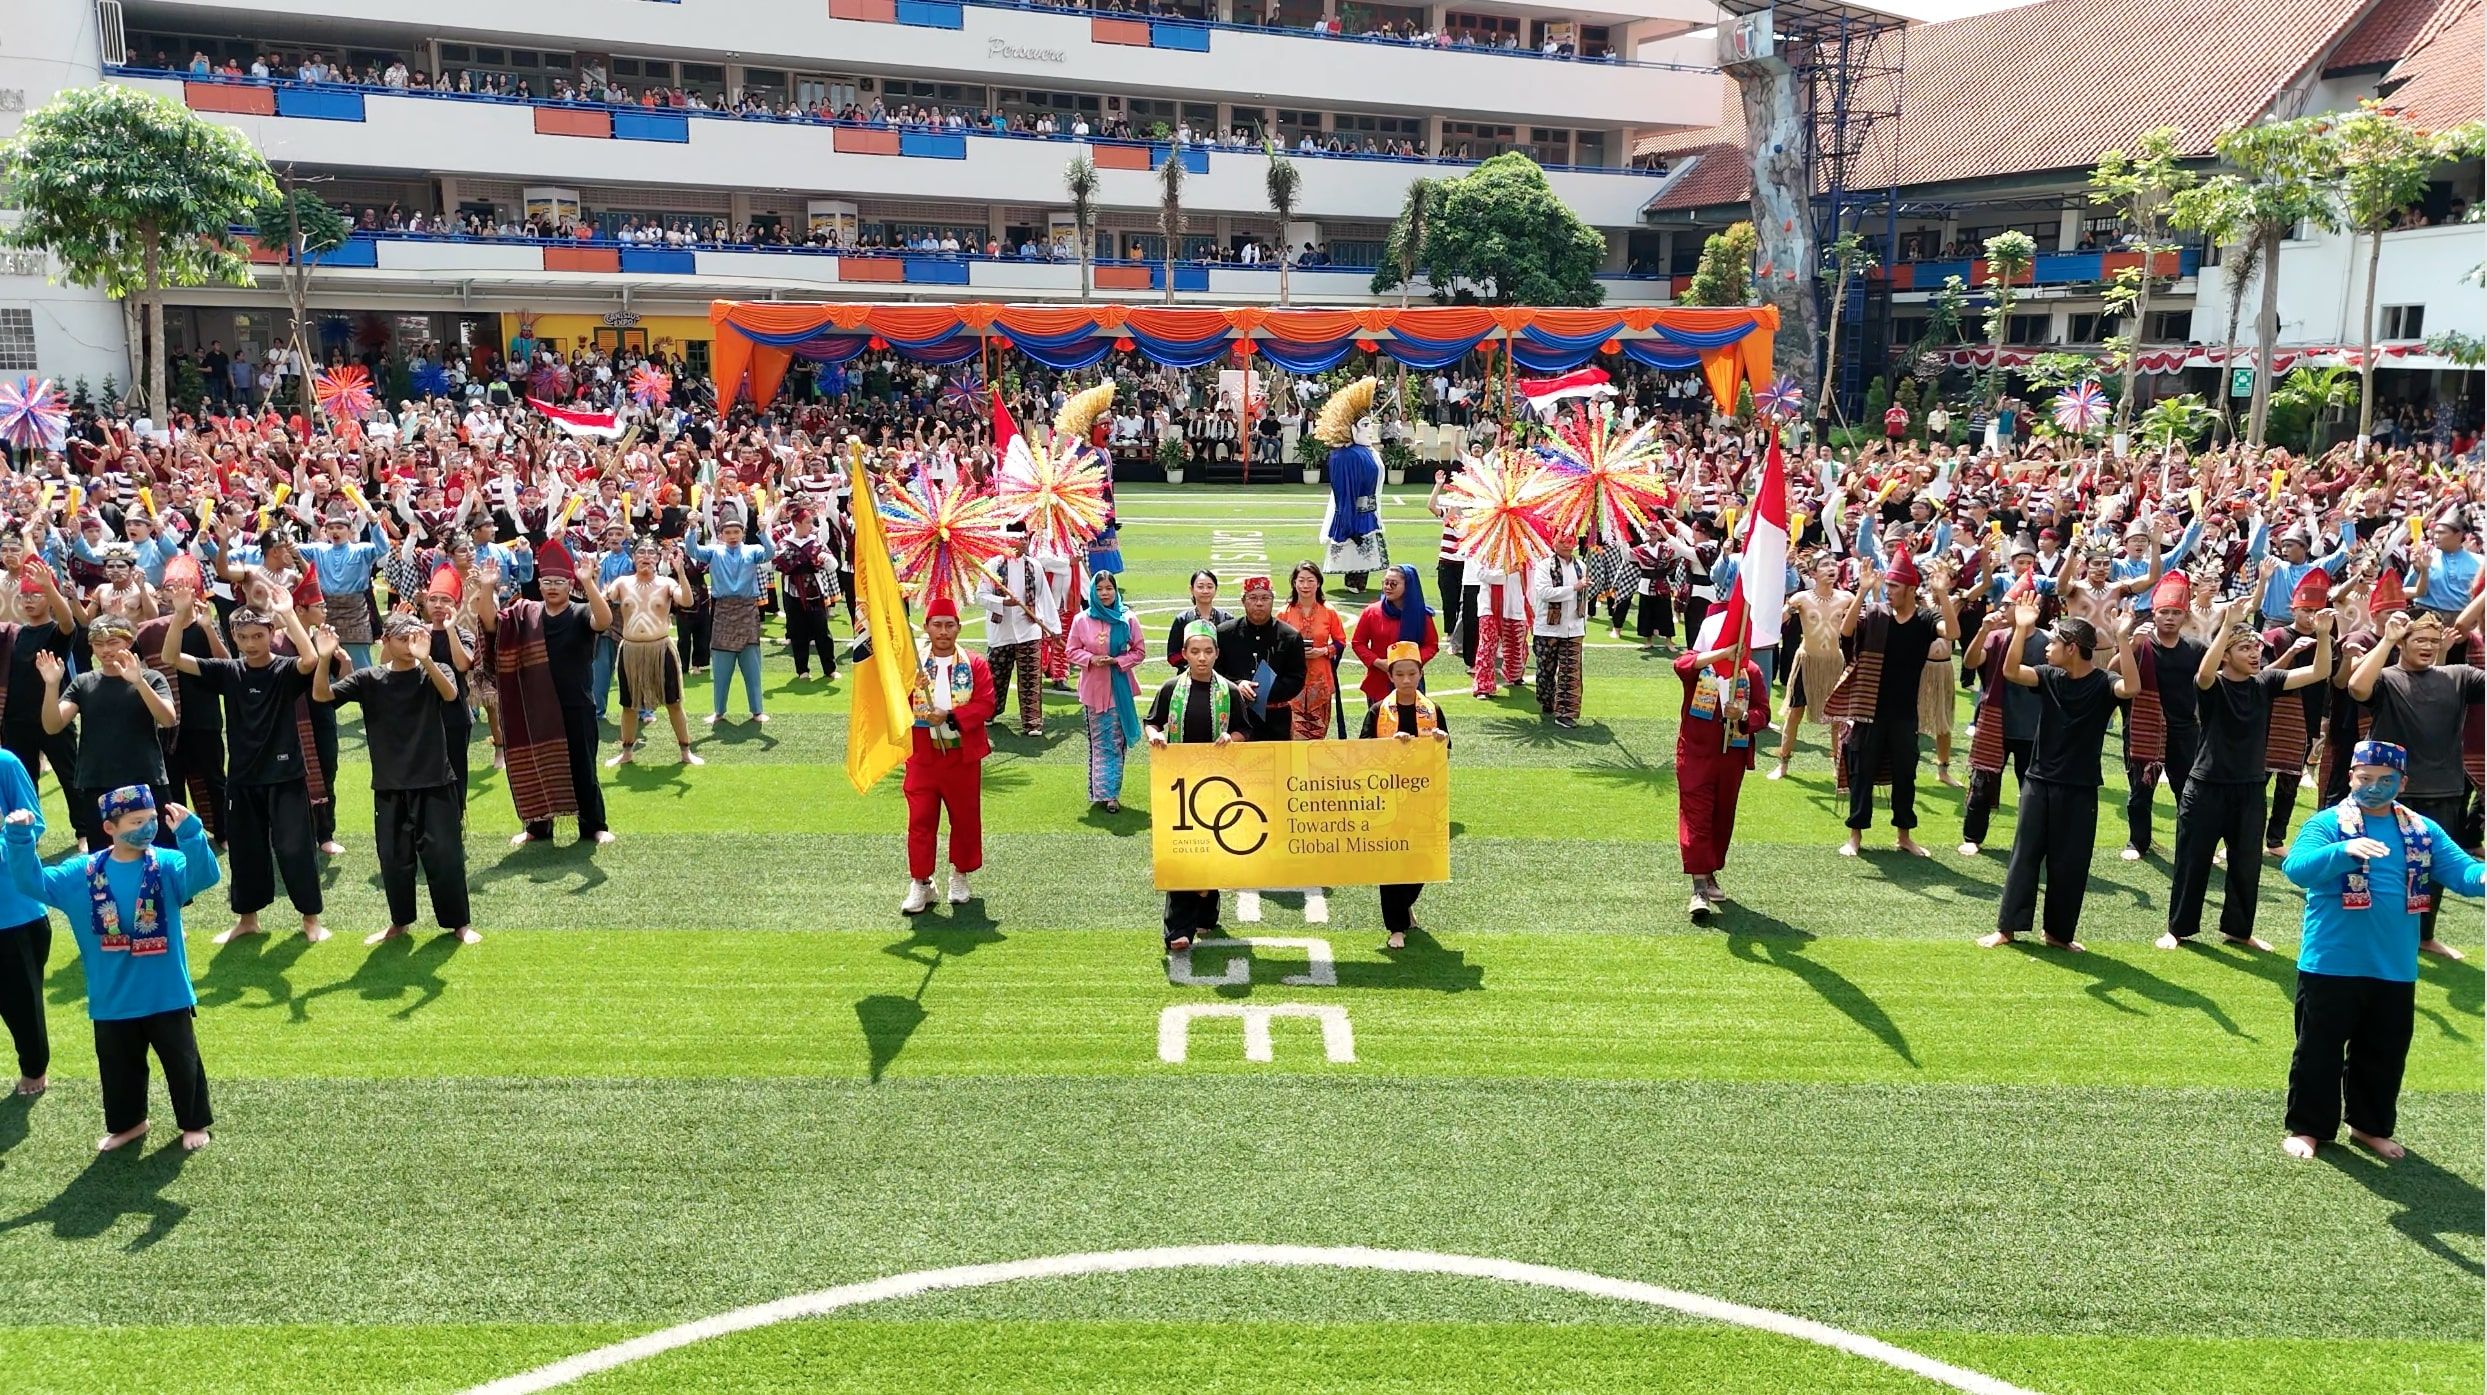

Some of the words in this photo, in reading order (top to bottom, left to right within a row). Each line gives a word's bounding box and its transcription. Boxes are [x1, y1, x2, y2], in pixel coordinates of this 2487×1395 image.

[603, 311, 641, 325] CANISIUS
[614, 319, 634, 328] EXPO
[1286, 775, 1361, 792] Canisius
[1367, 774, 1430, 793] College
[1287, 795, 1386, 813] Centennial:
[1287, 817, 1356, 834] Towards
[1360, 820, 1370, 832] a
[1288, 837, 1340, 854] Global
[1346, 836, 1410, 853] Mission
